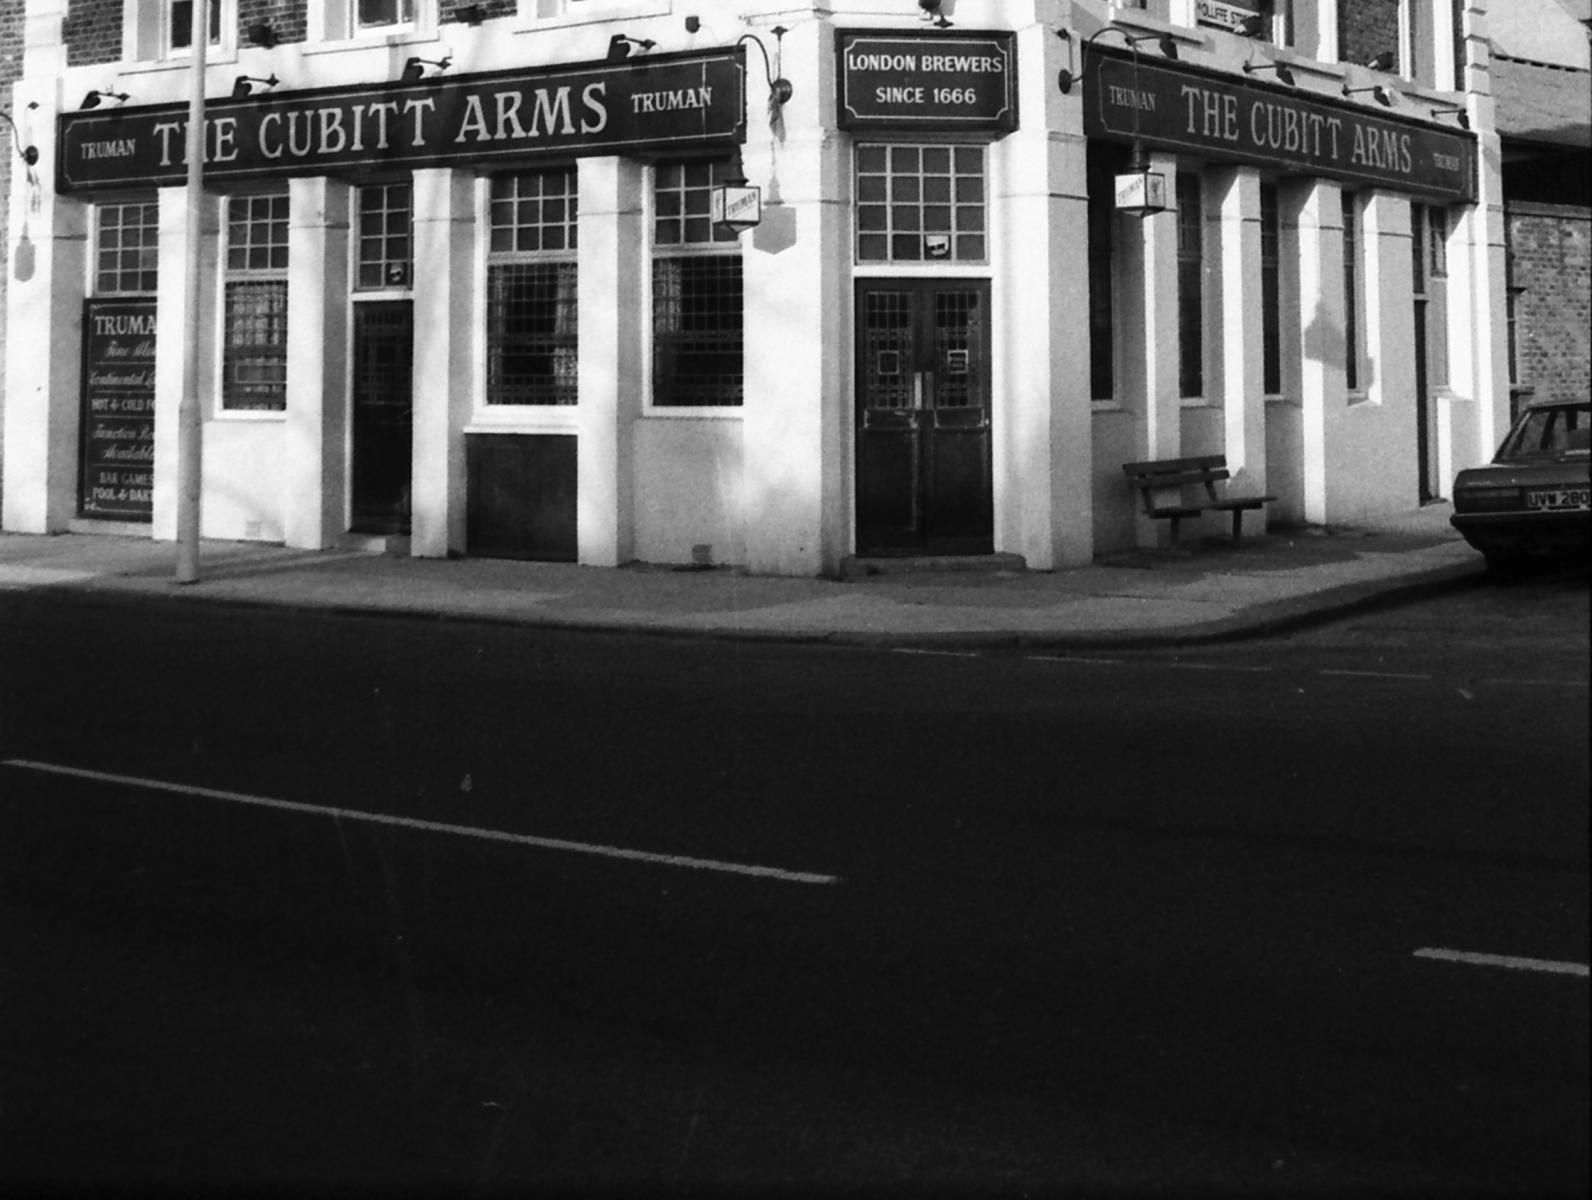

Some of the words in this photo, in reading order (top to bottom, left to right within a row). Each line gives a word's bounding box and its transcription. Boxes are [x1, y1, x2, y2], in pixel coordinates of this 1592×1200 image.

[849, 54, 916, 72] LONDON
[921, 55, 1003, 73] BREWERS
[875, 86, 925, 104] SINCE
[933, 87, 977, 105] 1666
[81, 138, 136, 160] TRUMAN
[258, 97, 435, 159] CUBITT
[454, 81, 608, 144] ARMS
[630, 86, 713, 114] TRUMAN
[1109, 84, 1156, 112] TRUMAN
[1181, 84, 1240, 141] THE
[1250, 101, 1342, 160] CUBITT
[1351, 123, 1412, 174] ARMS
[94, 314, 157, 335] TRUMA
